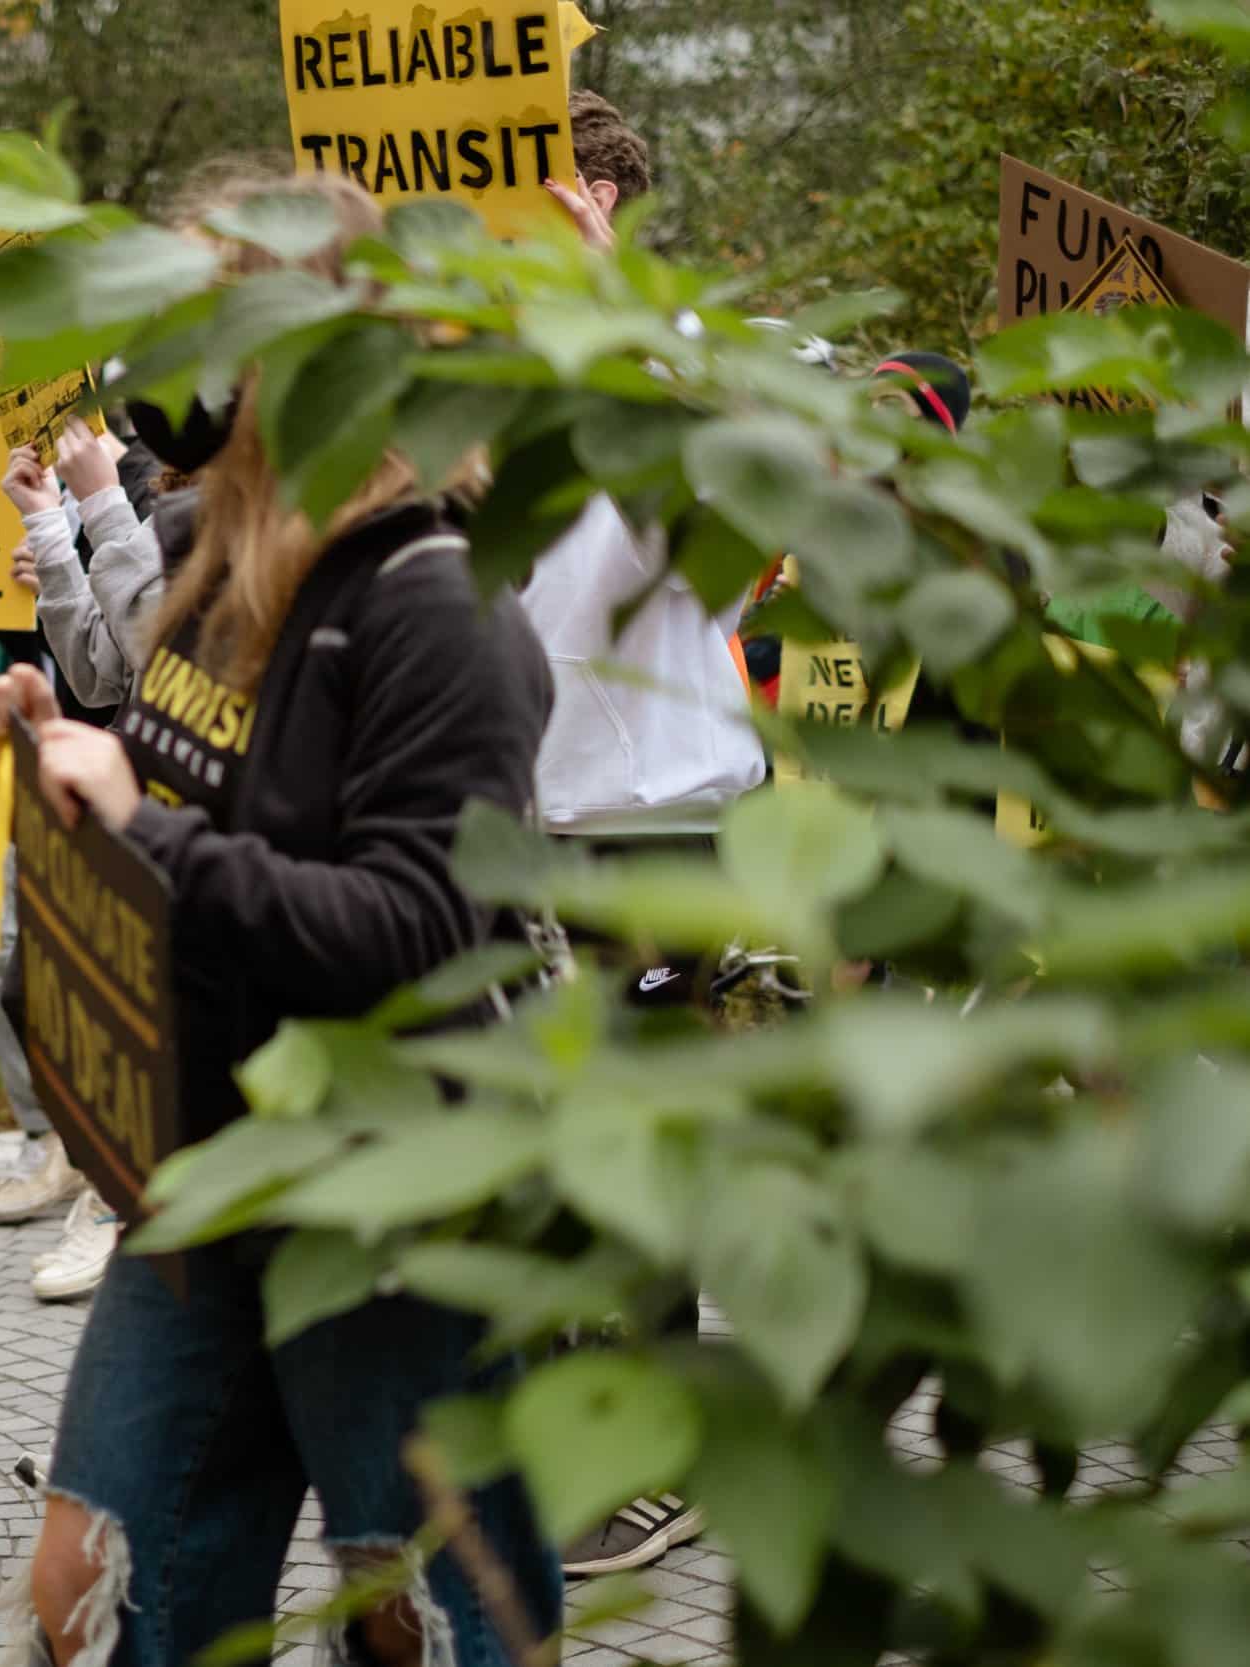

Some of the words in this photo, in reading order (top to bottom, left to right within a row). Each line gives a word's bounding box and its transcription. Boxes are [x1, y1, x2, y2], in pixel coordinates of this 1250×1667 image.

[294, 15, 549, 91] RELIABLE
[300, 123, 559, 193] TRANSIT
[644, 967, 671, 982] NIKE
